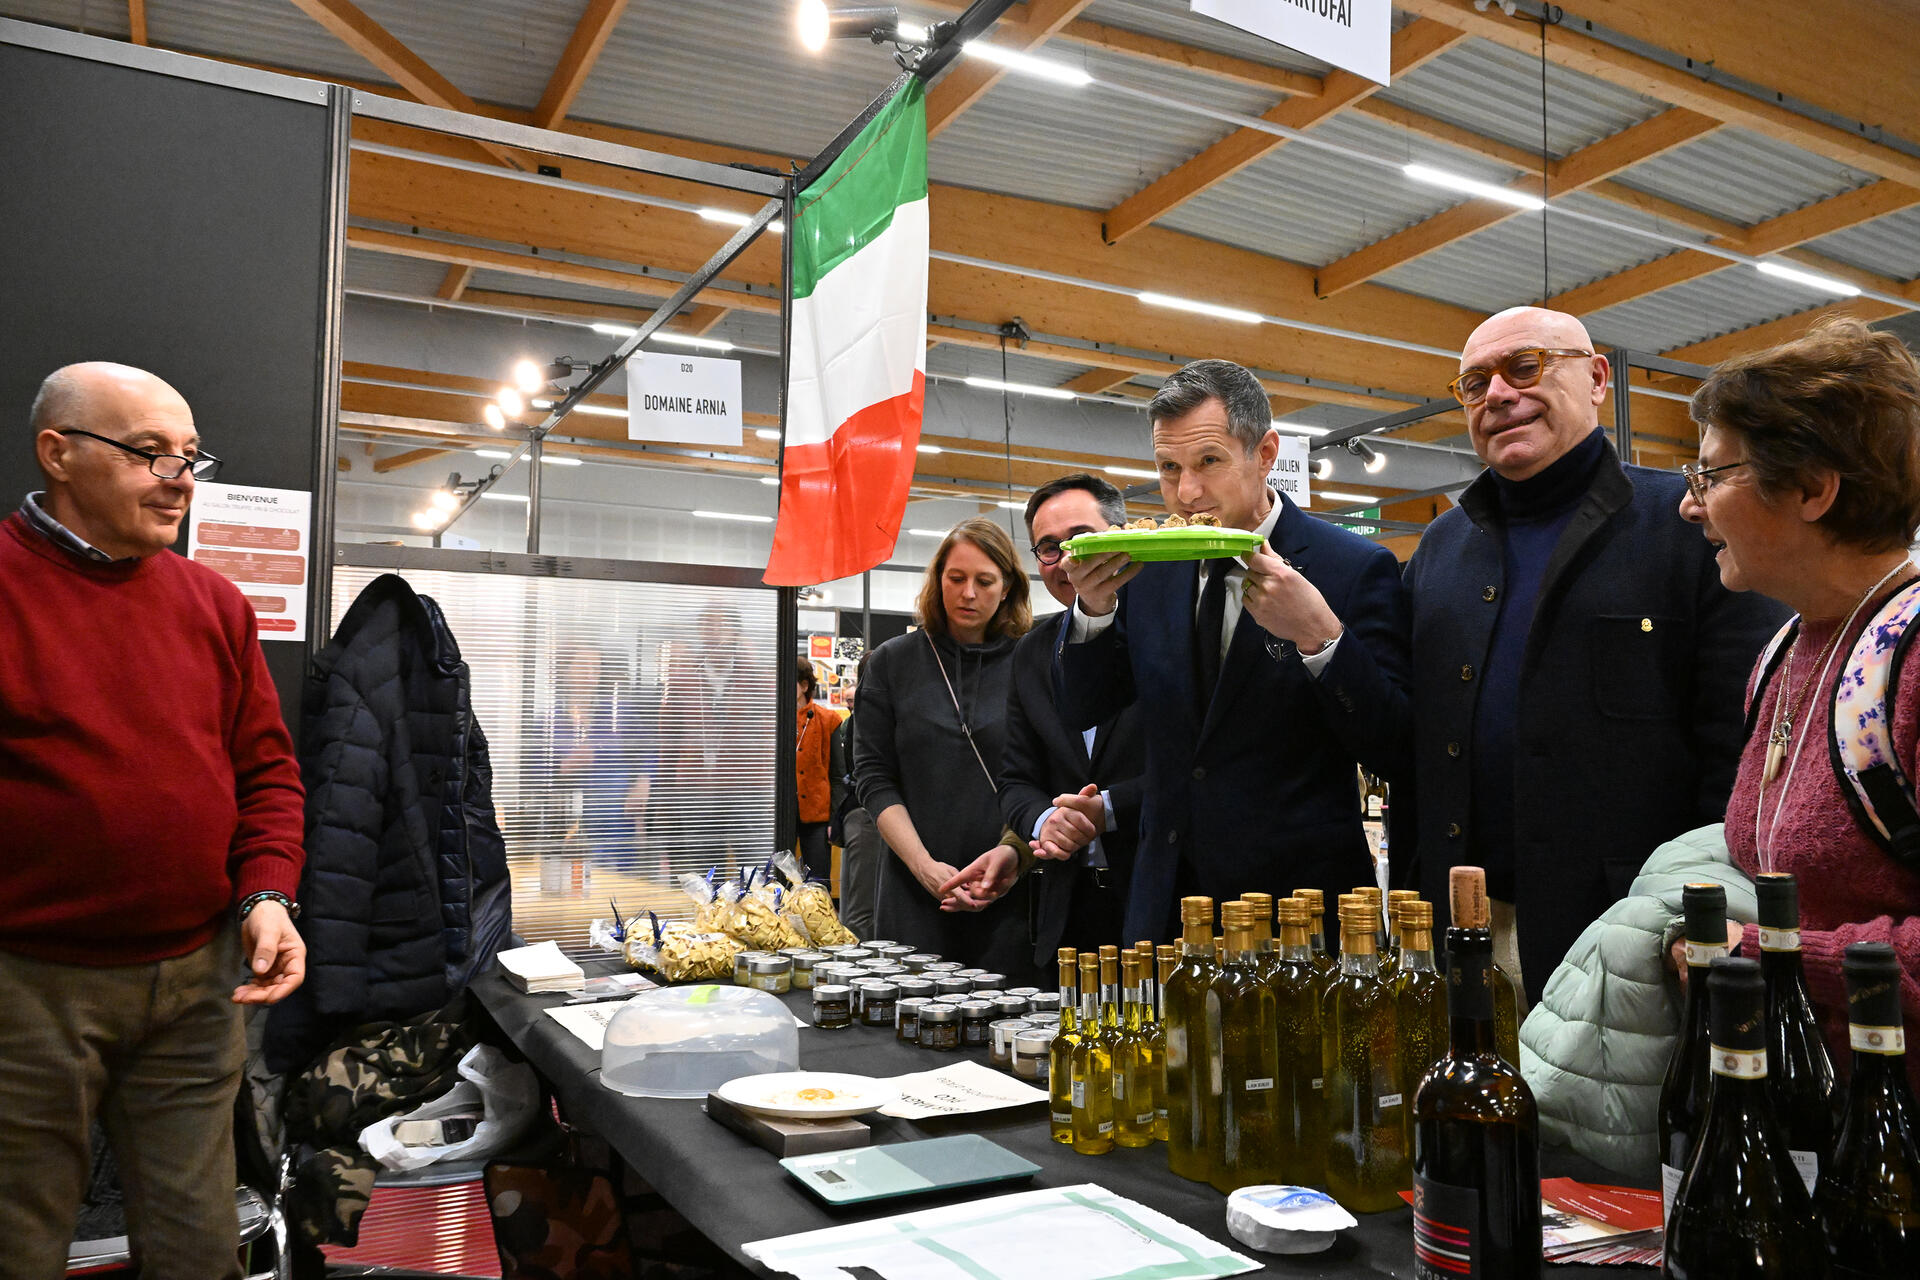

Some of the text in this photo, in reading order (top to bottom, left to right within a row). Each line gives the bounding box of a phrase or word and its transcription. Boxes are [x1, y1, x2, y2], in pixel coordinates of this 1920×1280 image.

[681, 363, 694, 374] D20
[644, 394, 727, 416] DOMAINE ARNIA
[1276, 459, 1300, 472] JULIEN
[227, 493, 279, 504] BIENVENUE
